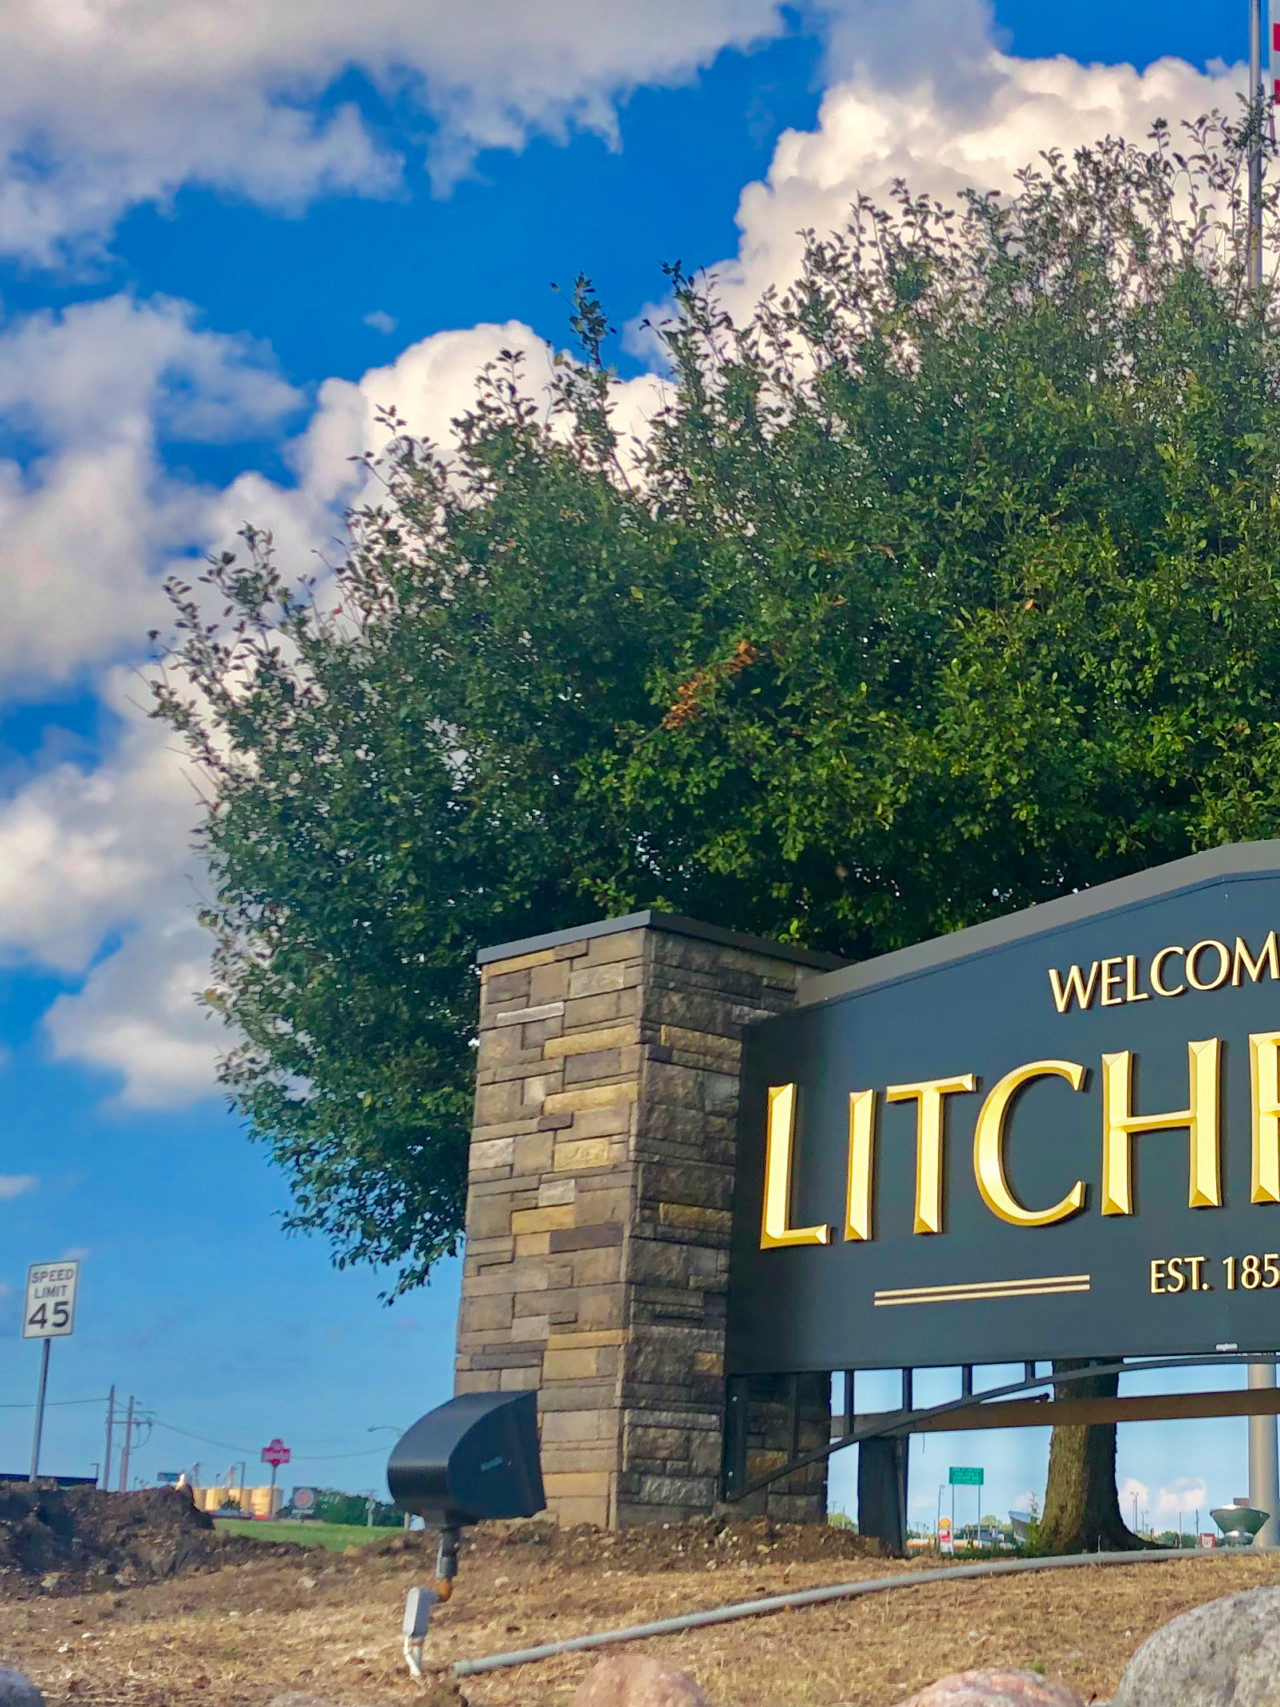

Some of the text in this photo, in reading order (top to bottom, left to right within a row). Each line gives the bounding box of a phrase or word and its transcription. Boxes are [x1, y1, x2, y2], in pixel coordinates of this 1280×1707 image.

[31, 1268, 75, 1284] SPEED
[1150, 1255, 1212, 1294] EST.
[34, 1284, 67, 1299] LIMIT
[27, 1301, 70, 1330] 45
